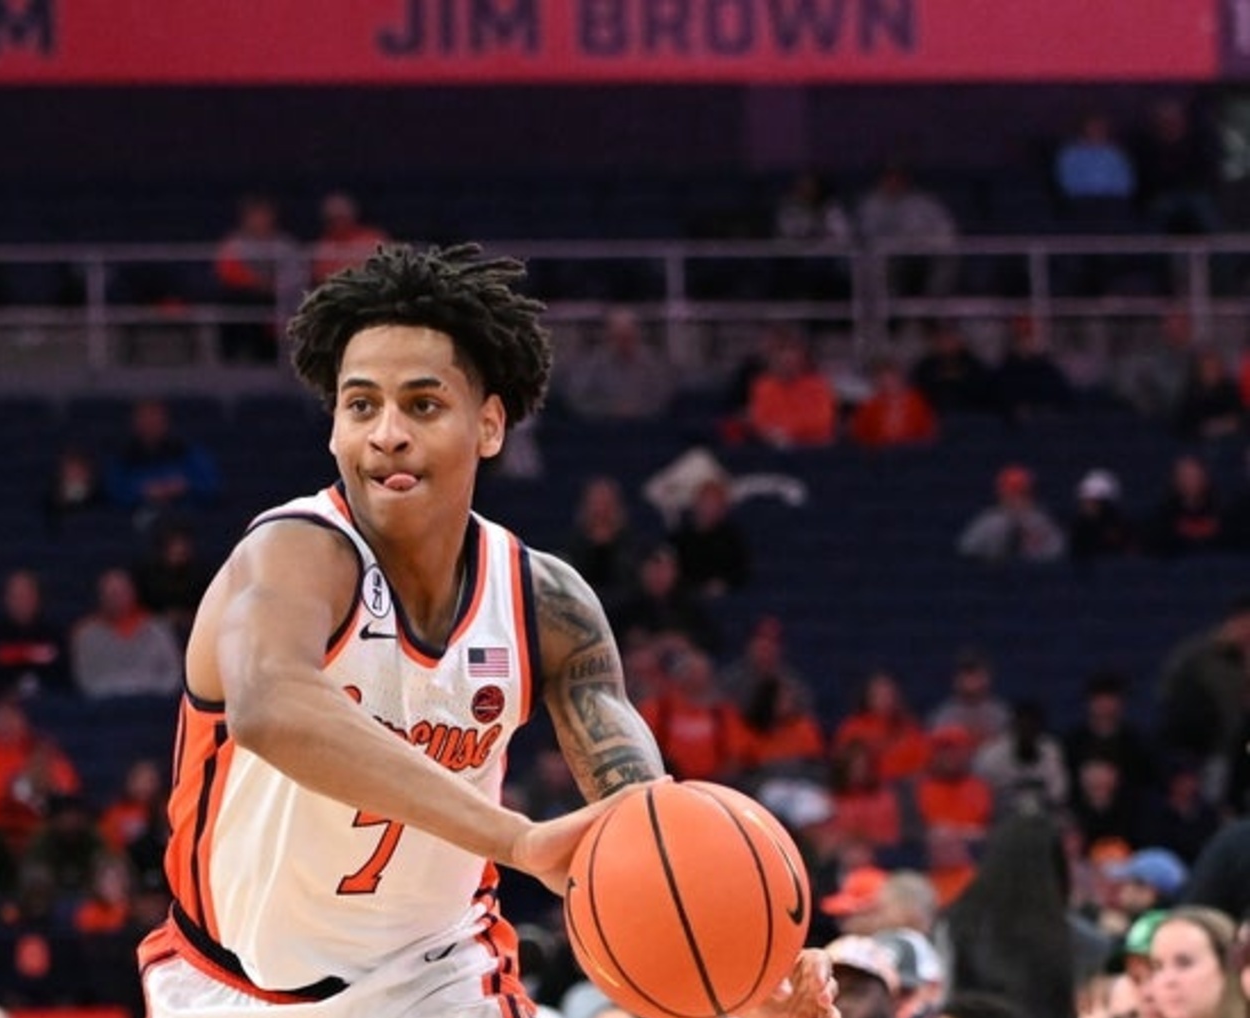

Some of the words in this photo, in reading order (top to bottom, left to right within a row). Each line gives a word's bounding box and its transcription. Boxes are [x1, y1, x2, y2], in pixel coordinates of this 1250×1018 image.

[375, 0, 540, 55] JIM
[577, 0, 918, 55] BROWN
[336, 810, 405, 895] 7
